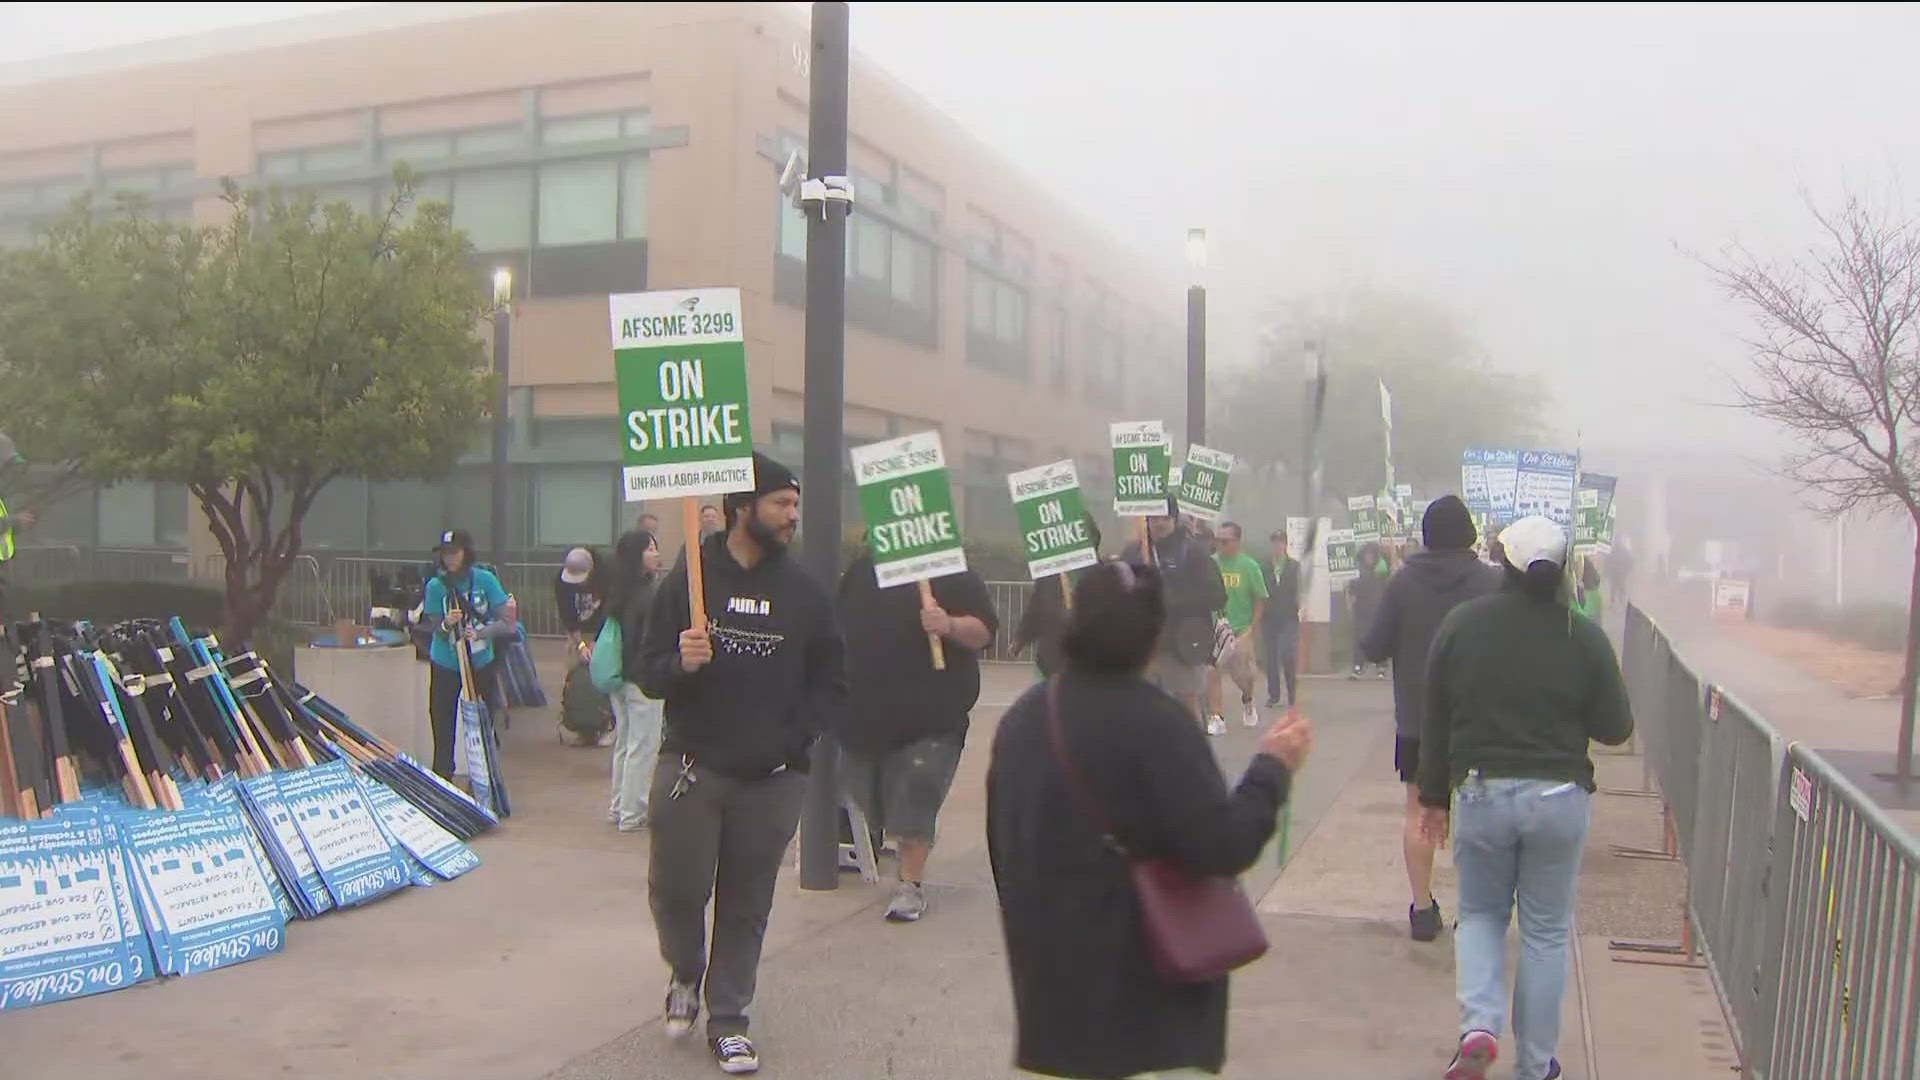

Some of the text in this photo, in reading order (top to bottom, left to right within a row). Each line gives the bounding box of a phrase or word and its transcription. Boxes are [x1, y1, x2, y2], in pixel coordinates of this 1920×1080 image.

[622, 313, 734, 339] AFSCME 3299
[659, 359, 704, 401] ON
[628, 403, 742, 451] STRIKE
[1129, 452, 1148, 473] ON
[630, 469, 748, 490] UNFAIR LABOR PRACTICE
[1118, 475, 1163, 494] STRIKE
[1197, 471, 1213, 487] ON
[890, 484, 923, 516] ON
[1182, 483, 1221, 506] STRIKE
[1038, 499, 1063, 524] ON
[873, 511, 955, 553] STRIKE
[1026, 519, 1088, 552] STRIKE
[727, 597, 770, 615] PUMA
[339, 870, 384, 904] Strike!
[383, 866, 401, 884] On
[54, 934, 73, 944] OUR
[76, 931, 95, 941] FOR
[185, 928, 279, 974] On Strike!
[0, 962, 123, 1009] On Strike!
